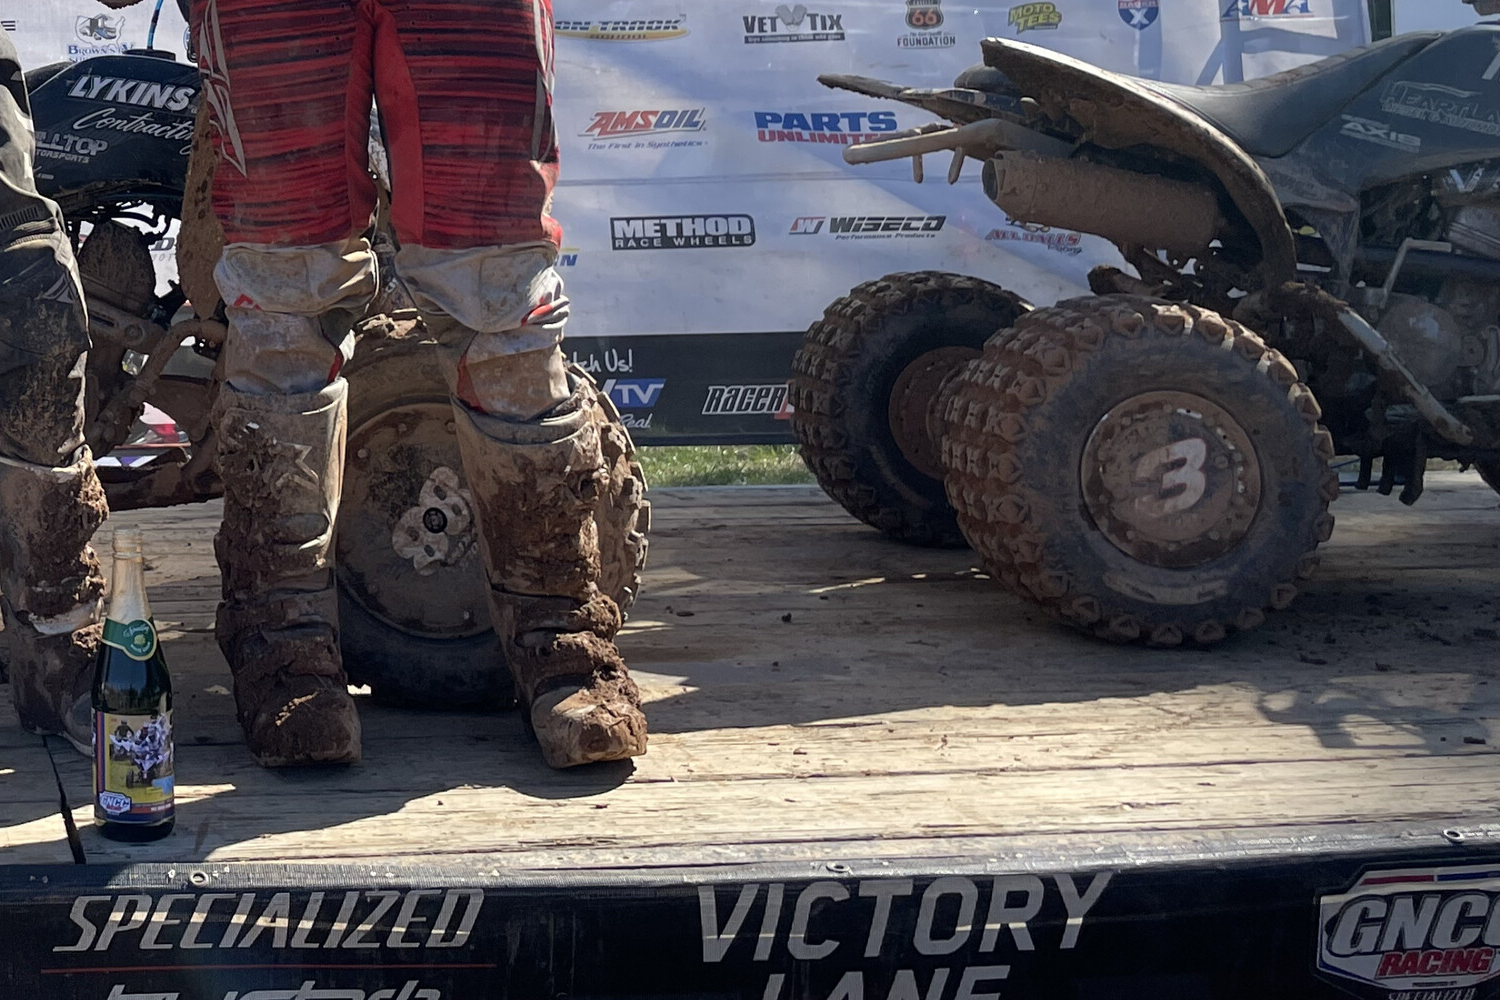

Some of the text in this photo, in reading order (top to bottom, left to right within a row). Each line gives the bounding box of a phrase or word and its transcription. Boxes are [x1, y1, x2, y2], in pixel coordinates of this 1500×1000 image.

[743, 13, 843, 34] VET TIX
[911, 9, 938, 26] 66
[1130, 8, 1149, 27] X
[897, 34, 956, 47] FOUNDATION
[67, 75, 196, 112] LYKINS
[585, 107, 707, 136] AMSOIL
[755, 111, 898, 133] PARTS
[646, 139, 702, 150] Synthetics
[613, 217, 751, 240] METHOD
[829, 215, 947, 233] WISECO
[615, 234, 752, 248] RACE WHEELS
[604, 349, 633, 373] Us!
[1134, 438, 1208, 513] 3
[101, 795, 130, 808] GNCC
[52, 888, 486, 953] SPECIALIZED
[700, 869, 1115, 964] VICTORY
[1329, 892, 1500, 957] GNC
[1375, 947, 1496, 980] RACING
